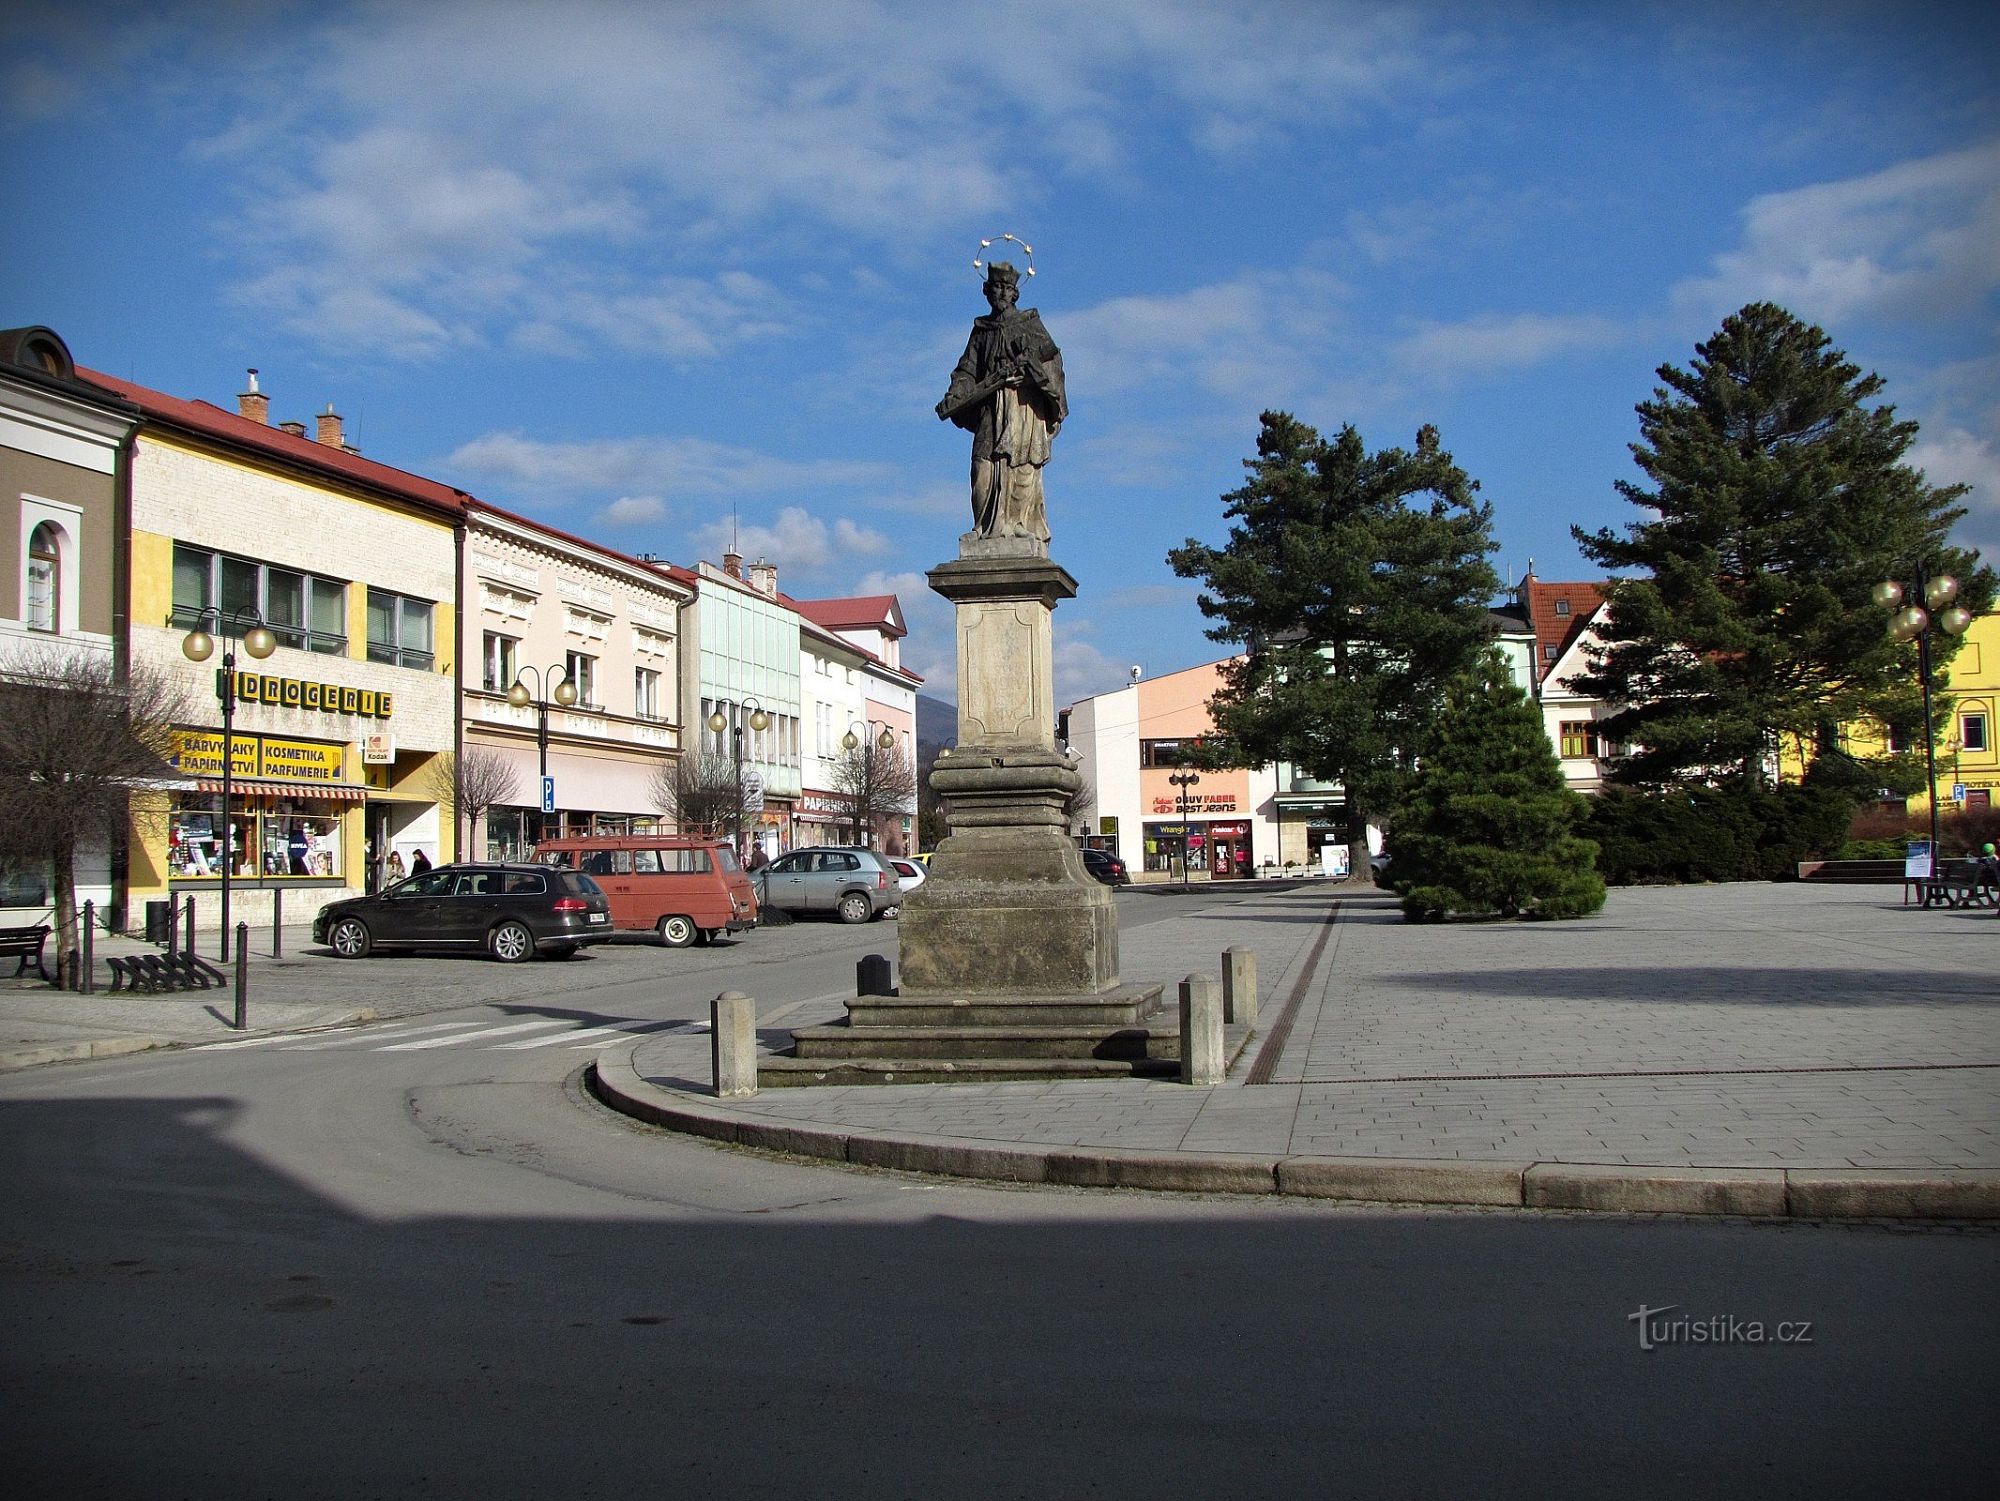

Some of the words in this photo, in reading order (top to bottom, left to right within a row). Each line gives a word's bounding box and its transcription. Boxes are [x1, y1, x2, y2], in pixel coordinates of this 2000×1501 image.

[246, 676, 391, 712] DROGERIE
[184, 738, 255, 756] BARVY-AKY
[265, 746, 325, 762] KOSMETIKA
[184, 756, 255, 773] PAPÍRNCTVÍ
[265, 763, 329, 779] PARFUMERIE
